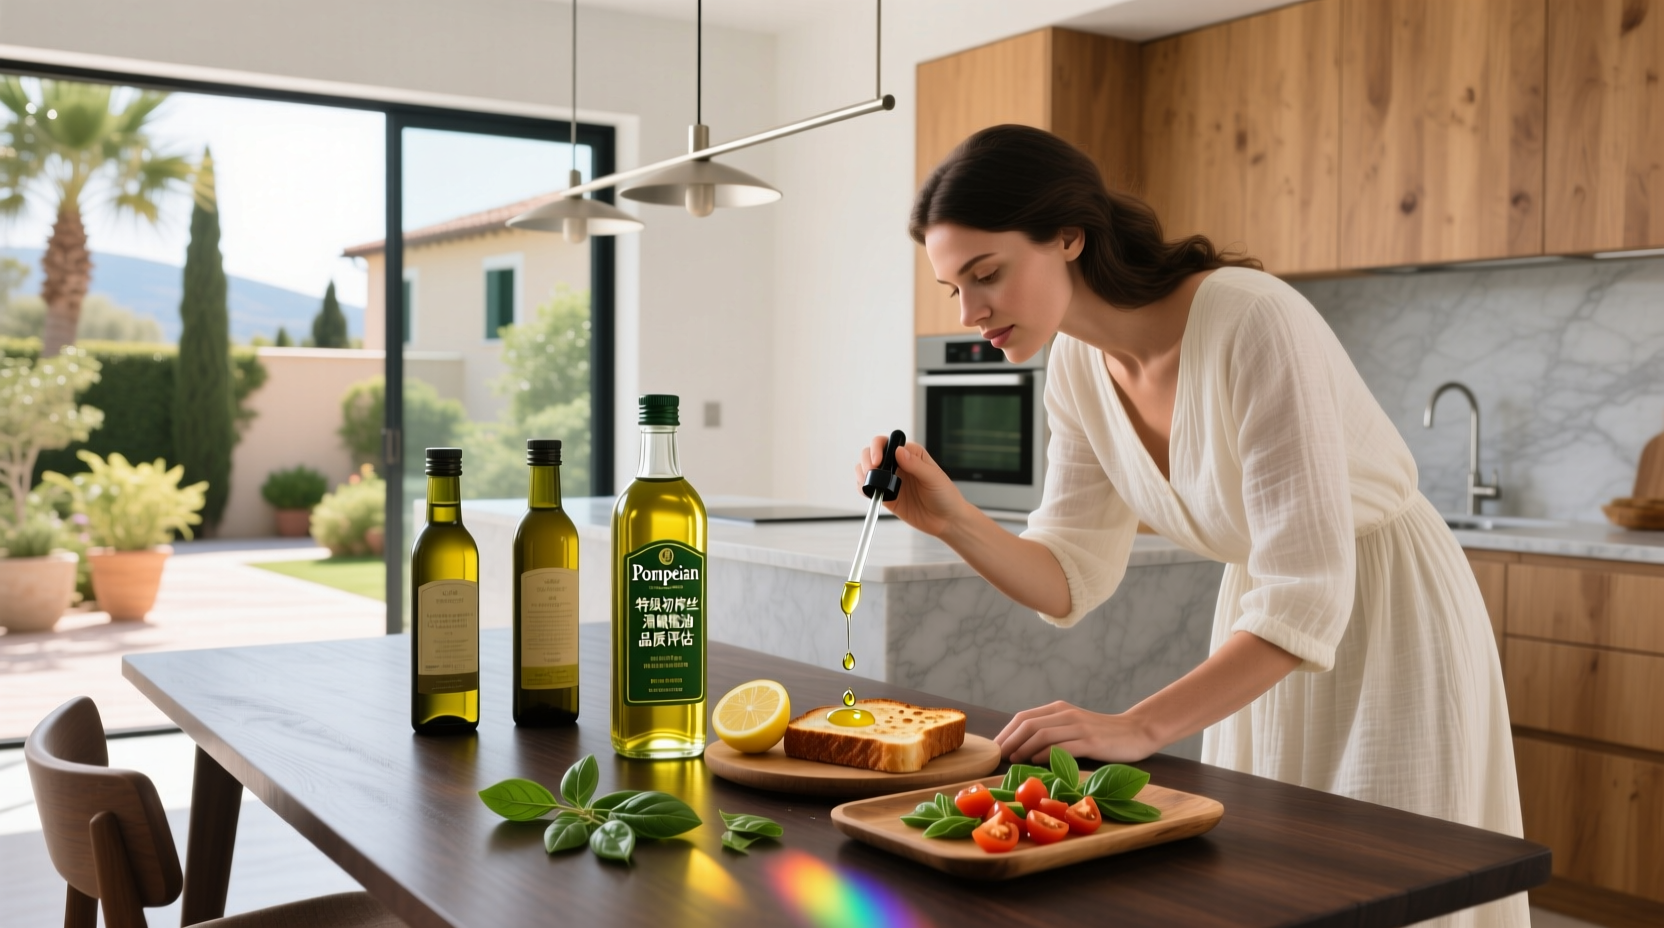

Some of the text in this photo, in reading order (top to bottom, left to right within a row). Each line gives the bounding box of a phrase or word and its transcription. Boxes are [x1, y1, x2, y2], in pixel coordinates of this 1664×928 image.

[632, 564, 699, 586] Pompeian
[638, 631, 694, 647] 品质评估
